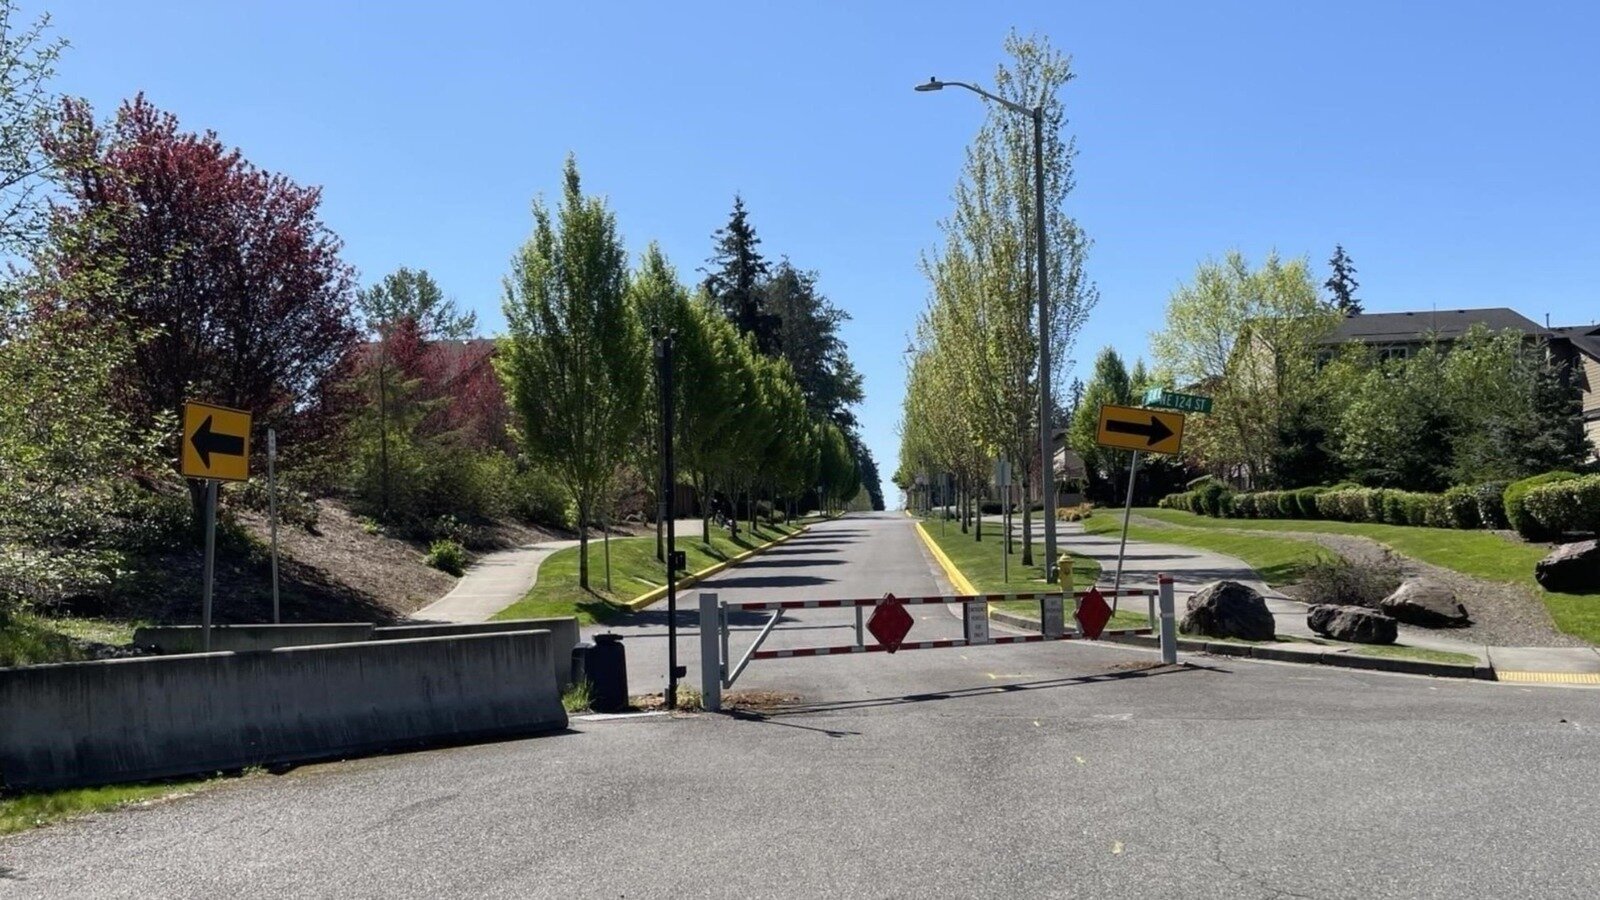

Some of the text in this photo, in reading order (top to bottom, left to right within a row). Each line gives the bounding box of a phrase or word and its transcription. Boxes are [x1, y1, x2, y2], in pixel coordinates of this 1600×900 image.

[1160, 395, 1172, 407] NE
[1175, 396, 1192, 409] 124
[1195, 398, 1206, 411] ST
